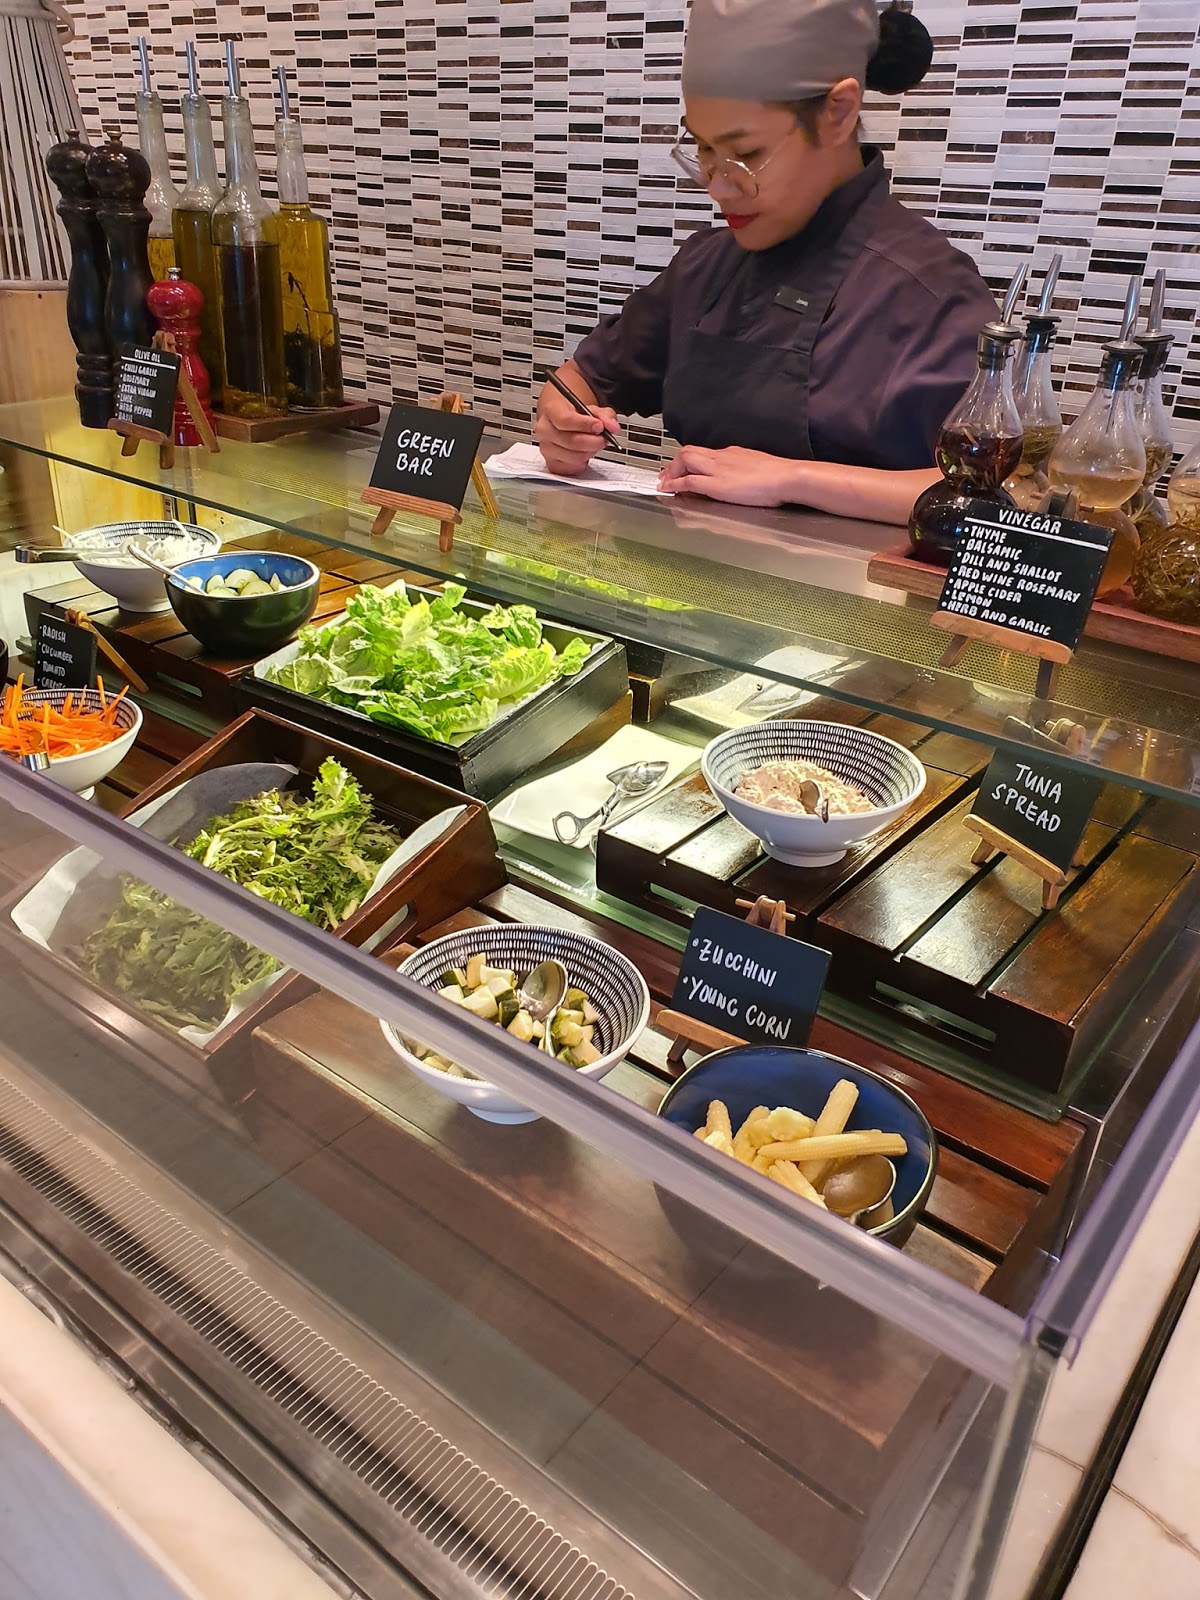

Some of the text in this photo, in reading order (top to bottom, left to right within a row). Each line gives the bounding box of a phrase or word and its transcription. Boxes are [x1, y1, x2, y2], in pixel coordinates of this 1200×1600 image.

[134, 349, 161, 363] OLIVE OIL
[122, 374, 150, 387] ROSEMARY
[124, 363, 158, 377] CHILI GARLIC
[121, 384, 157, 398] EXTRA VIRGIN
[133, 405, 153, 418] PEPPER
[397, 429, 455, 458] GREEN
[396, 453, 433, 476] BAR
[999, 508, 1062, 534] VINEGAR
[970, 525, 1007, 544] THYME
[966, 539, 1022, 561] BALSAMIC
[961, 552, 1062, 583] DILL AND SHALLOT
[953, 578, 1022, 604] APPLE CIDER
[957, 565, 1081, 604] RED WINE ROSEMARY
[951, 589, 992, 608] LEMON
[946, 600, 1051, 636] HERB AND GARLIC
[42, 624, 67, 643] RADISH
[41, 643, 74, 664] CUCUMBER
[42, 661, 66, 677] TOMATO
[1015, 763, 1062, 804] TUNA
[991, 783, 1061, 832] SPREAD
[698, 938, 778, 987] ZUCCHINI
[688, 975, 792, 1040] YOUNG CORN
